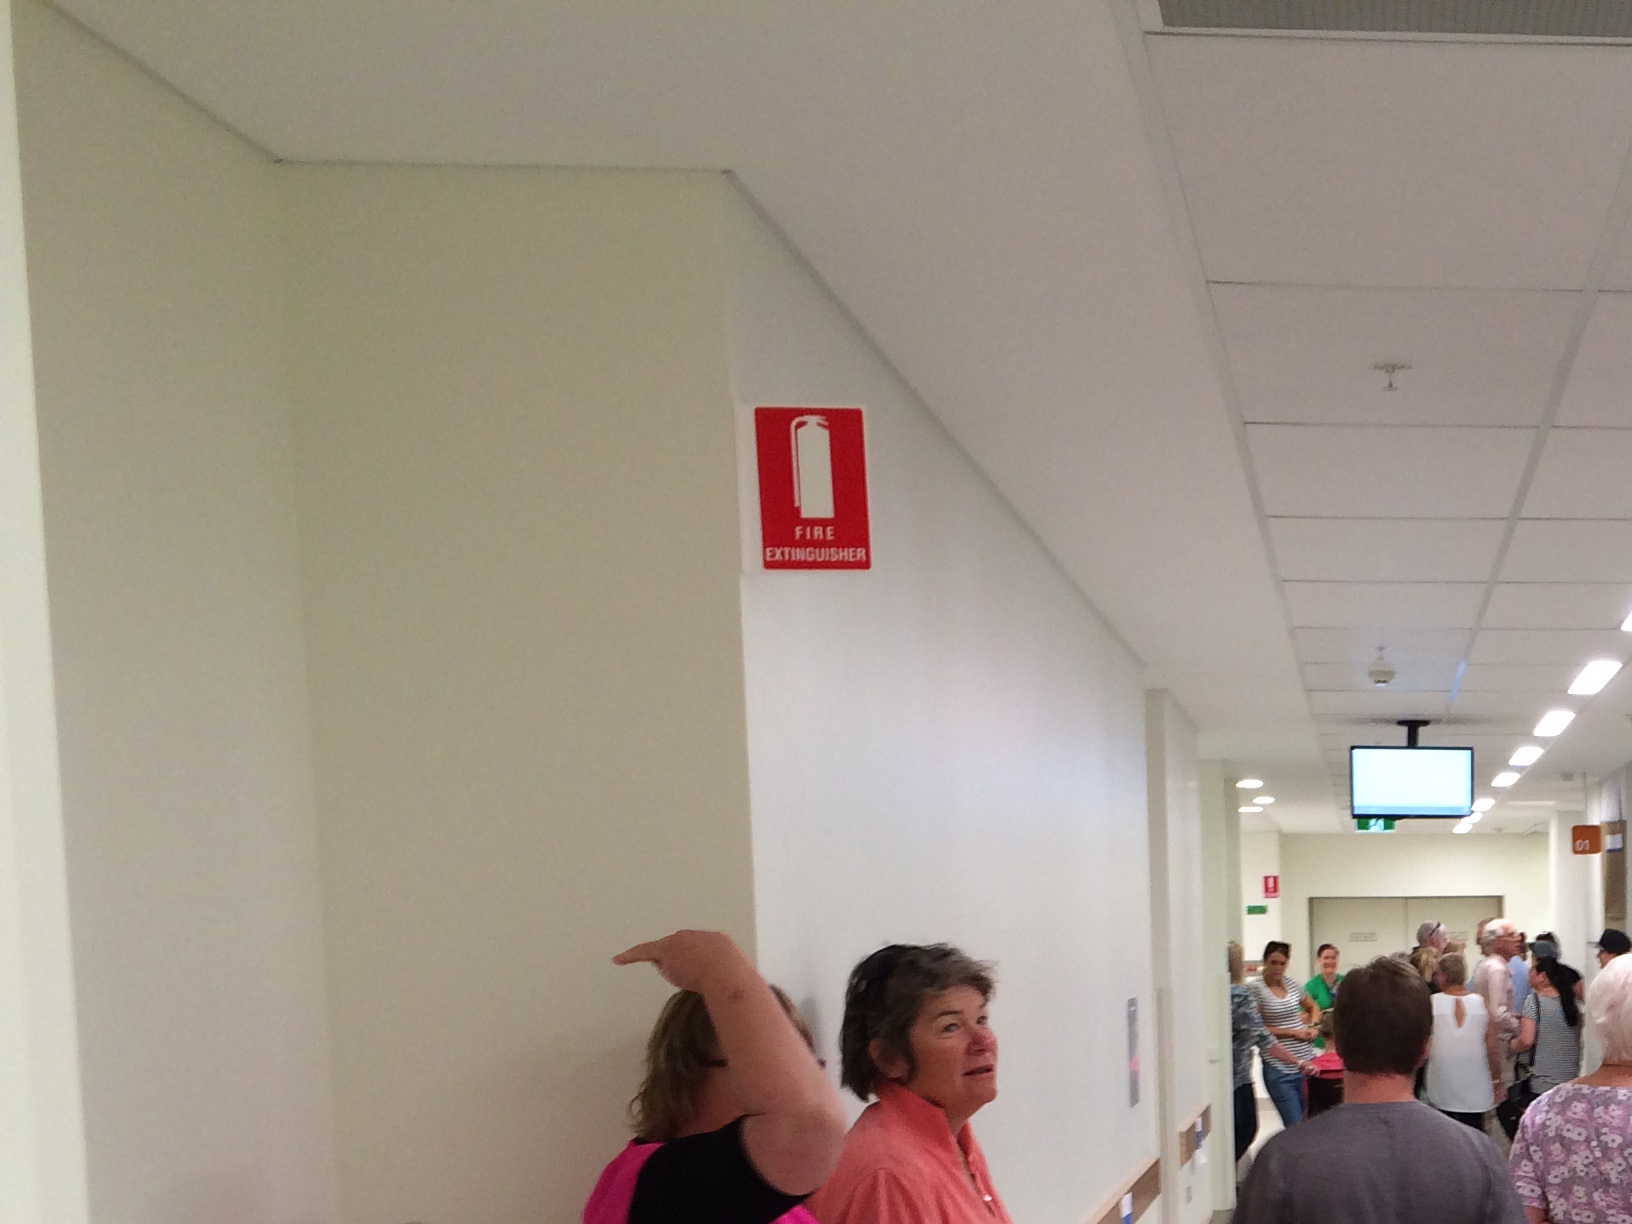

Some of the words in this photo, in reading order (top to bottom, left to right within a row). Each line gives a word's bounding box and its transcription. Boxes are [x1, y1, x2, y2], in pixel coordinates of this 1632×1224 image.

[794, 525, 835, 540] FIRE
[765, 546, 867, 562] EXTINGUISHER
[1575, 839, 1590, 851] 01
